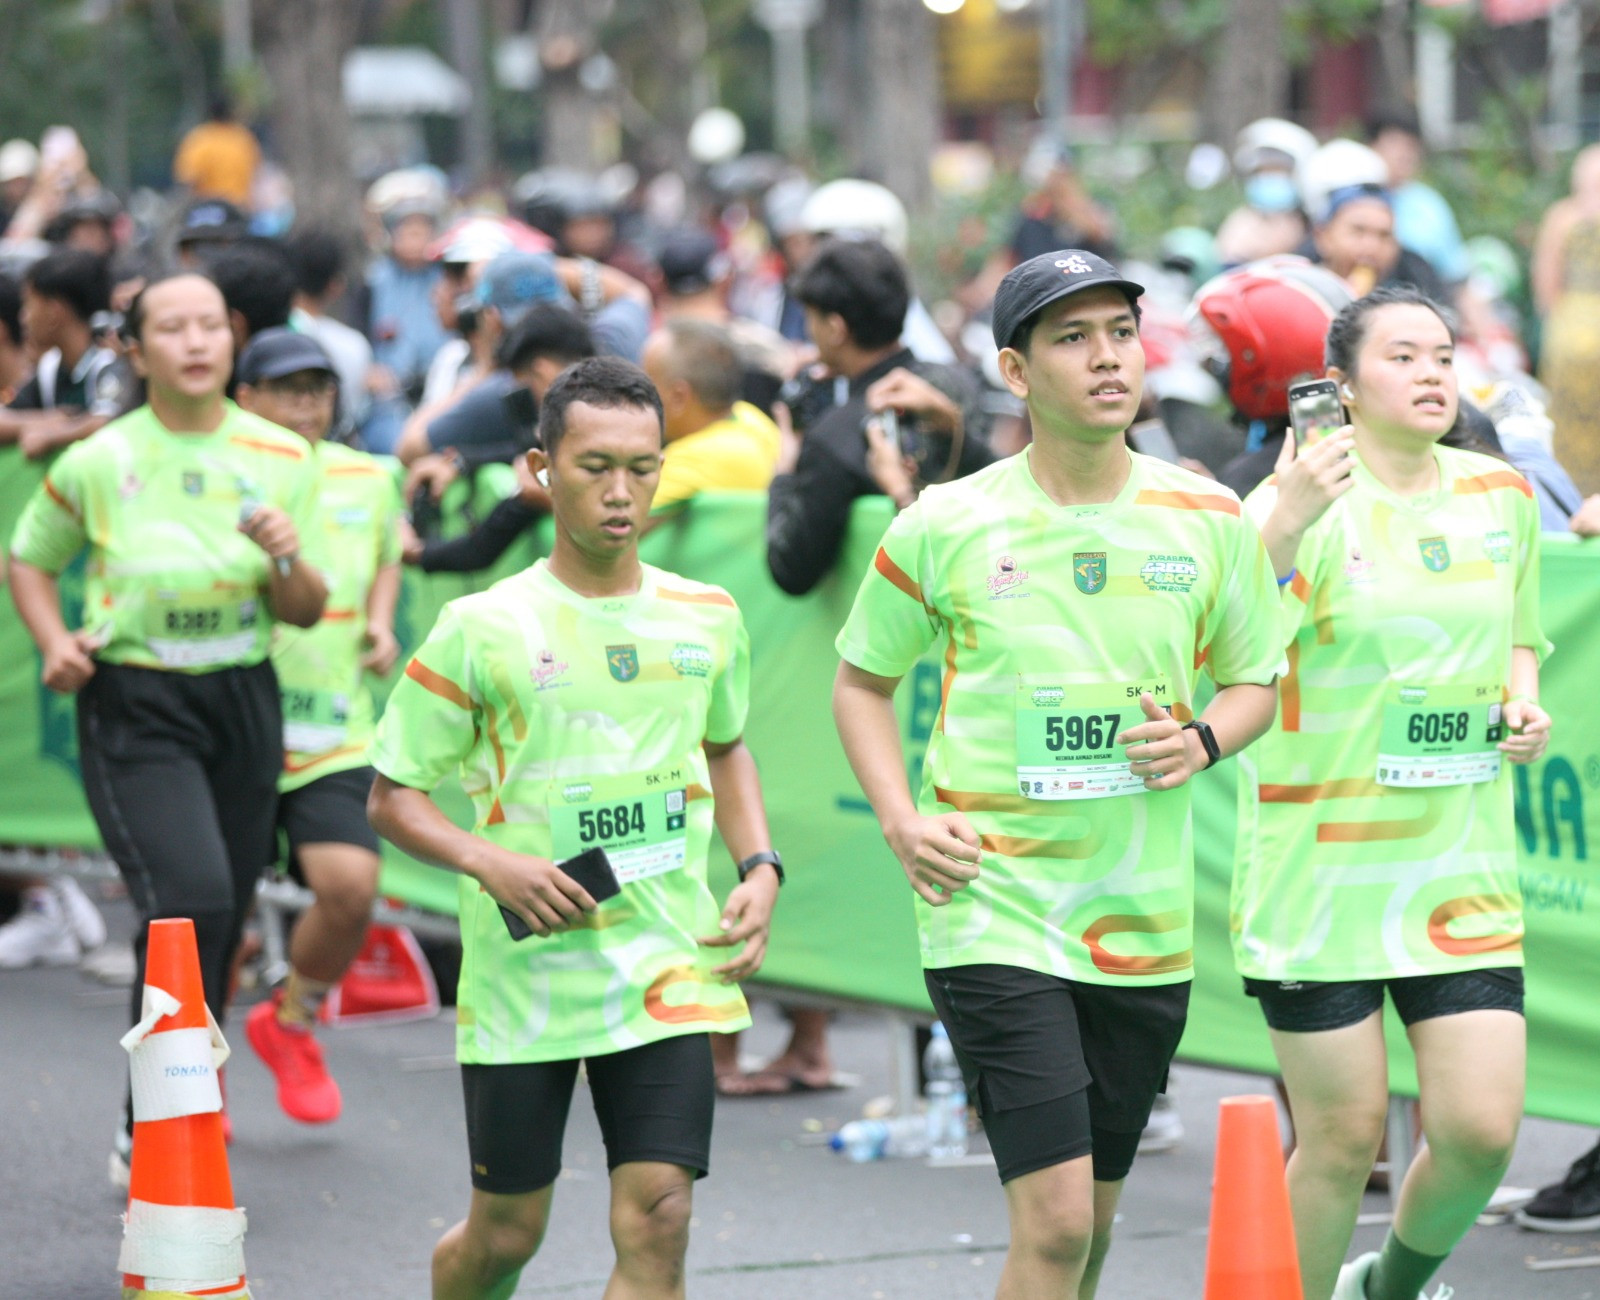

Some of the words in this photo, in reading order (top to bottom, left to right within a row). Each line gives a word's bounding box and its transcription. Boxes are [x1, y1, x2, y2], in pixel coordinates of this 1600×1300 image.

[1147, 554, 1195, 563] SURABAYA
[1141, 562, 1198, 575] GREEN
[1140, 573, 1197, 586] FORCE
[1168, 585, 1191, 593] 2025
[1126, 686, 1142, 698] 5K
[1155, 685, 1166, 695] M
[1045, 714, 1121, 751] 5967
[1408, 712, 1470, 743] 6058
[646, 774, 661, 785] 5K
[671, 770, 681, 780] M
[578, 802, 646, 843] 5684
